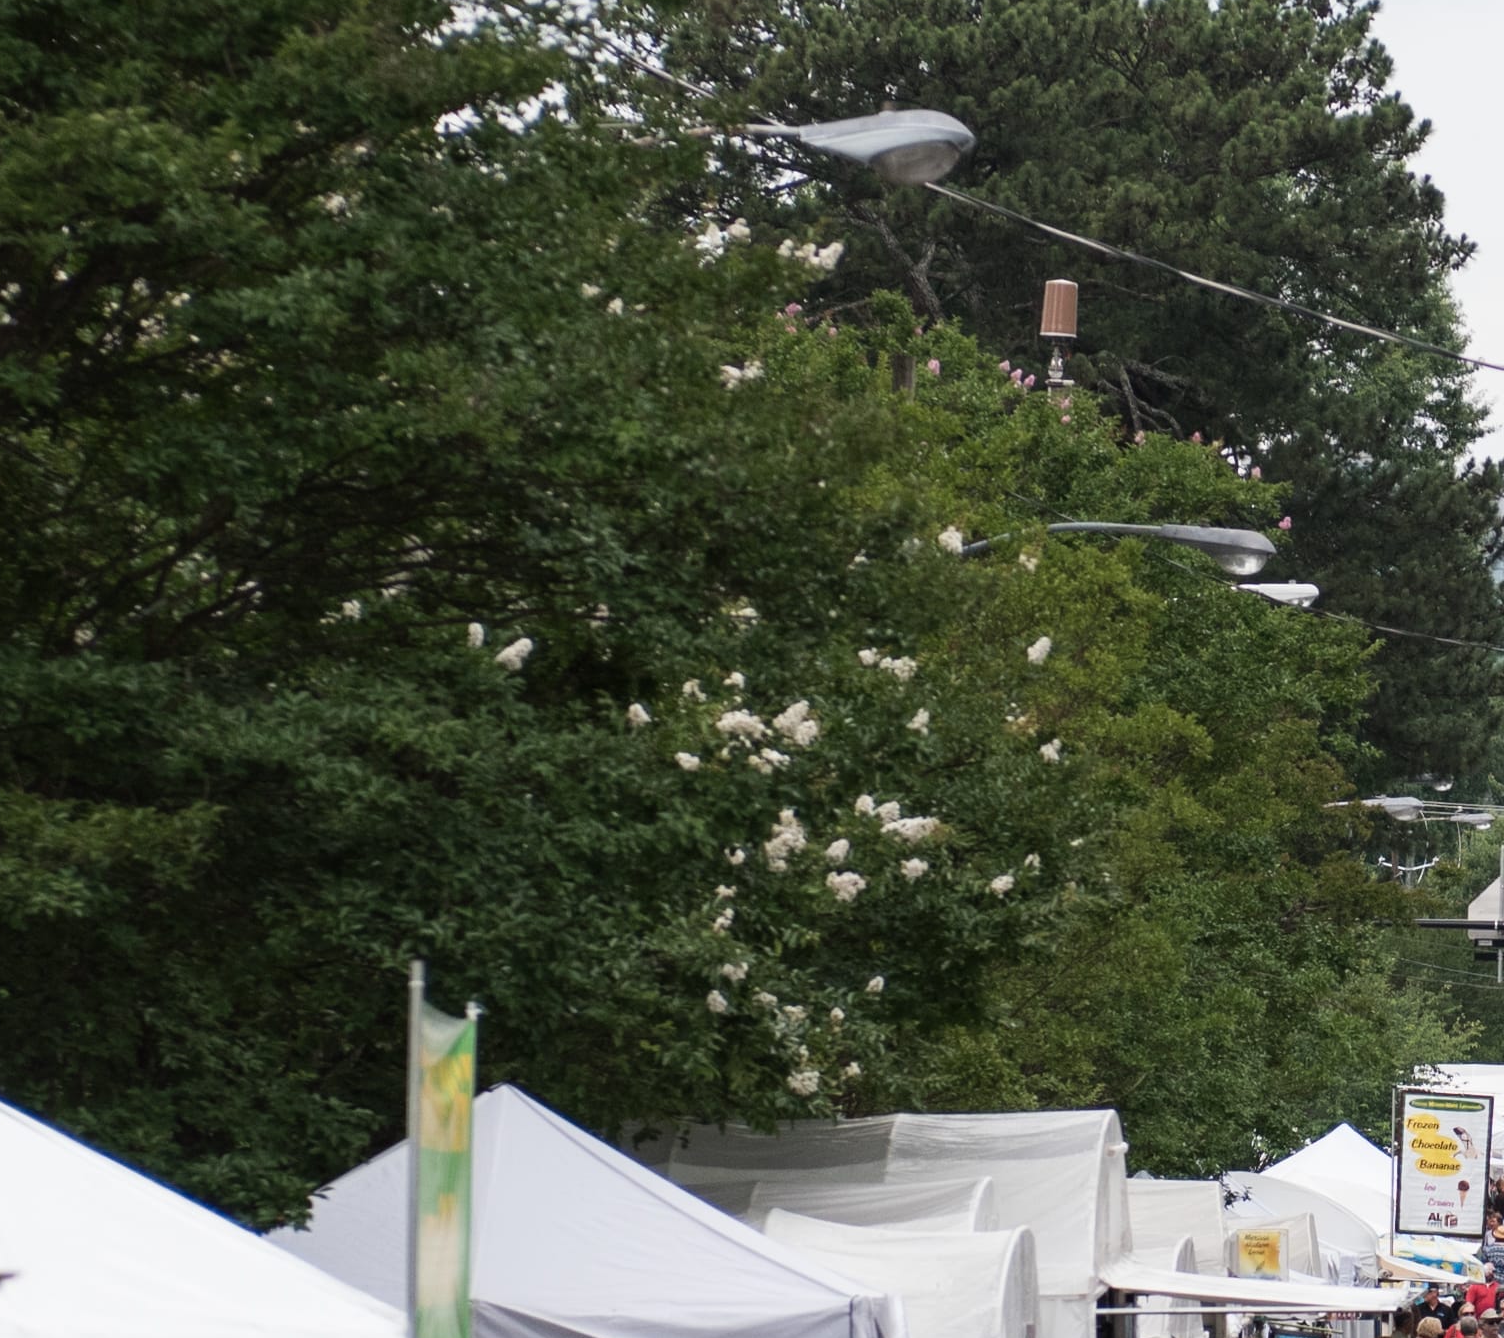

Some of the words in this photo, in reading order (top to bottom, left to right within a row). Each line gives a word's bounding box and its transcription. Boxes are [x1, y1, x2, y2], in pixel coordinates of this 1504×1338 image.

[1407, 1119, 1440, 1130] Frozen
[1411, 1139, 1458, 1151] Chocolate
[1419, 1159, 1461, 1171] Bananas
